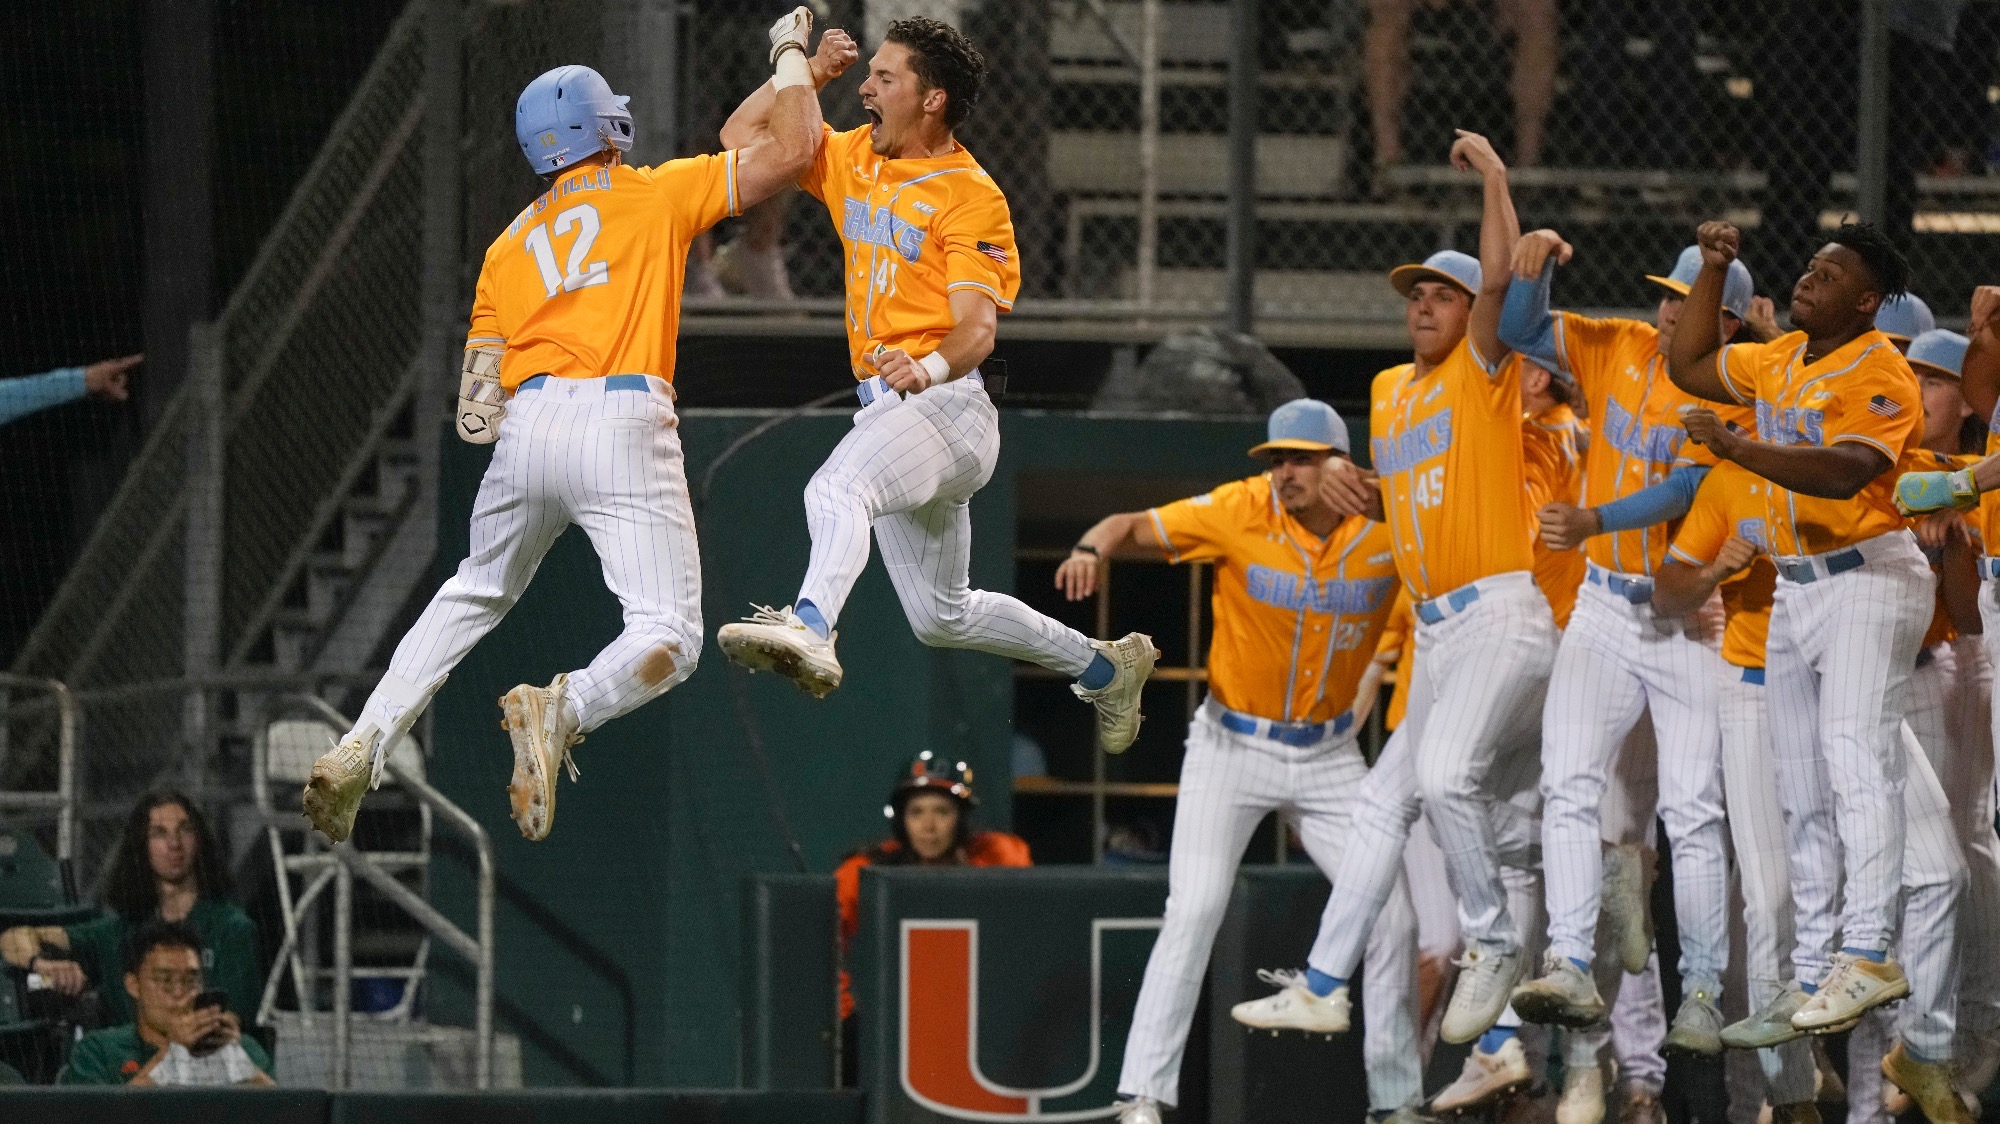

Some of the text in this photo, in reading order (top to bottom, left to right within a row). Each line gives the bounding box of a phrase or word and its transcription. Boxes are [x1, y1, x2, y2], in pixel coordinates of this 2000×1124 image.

[541, 133, 558, 147] 12
[525, 203, 609, 299] 12
[1416, 465, 1445, 509] 45
[900, 918, 1166, 1122] U
